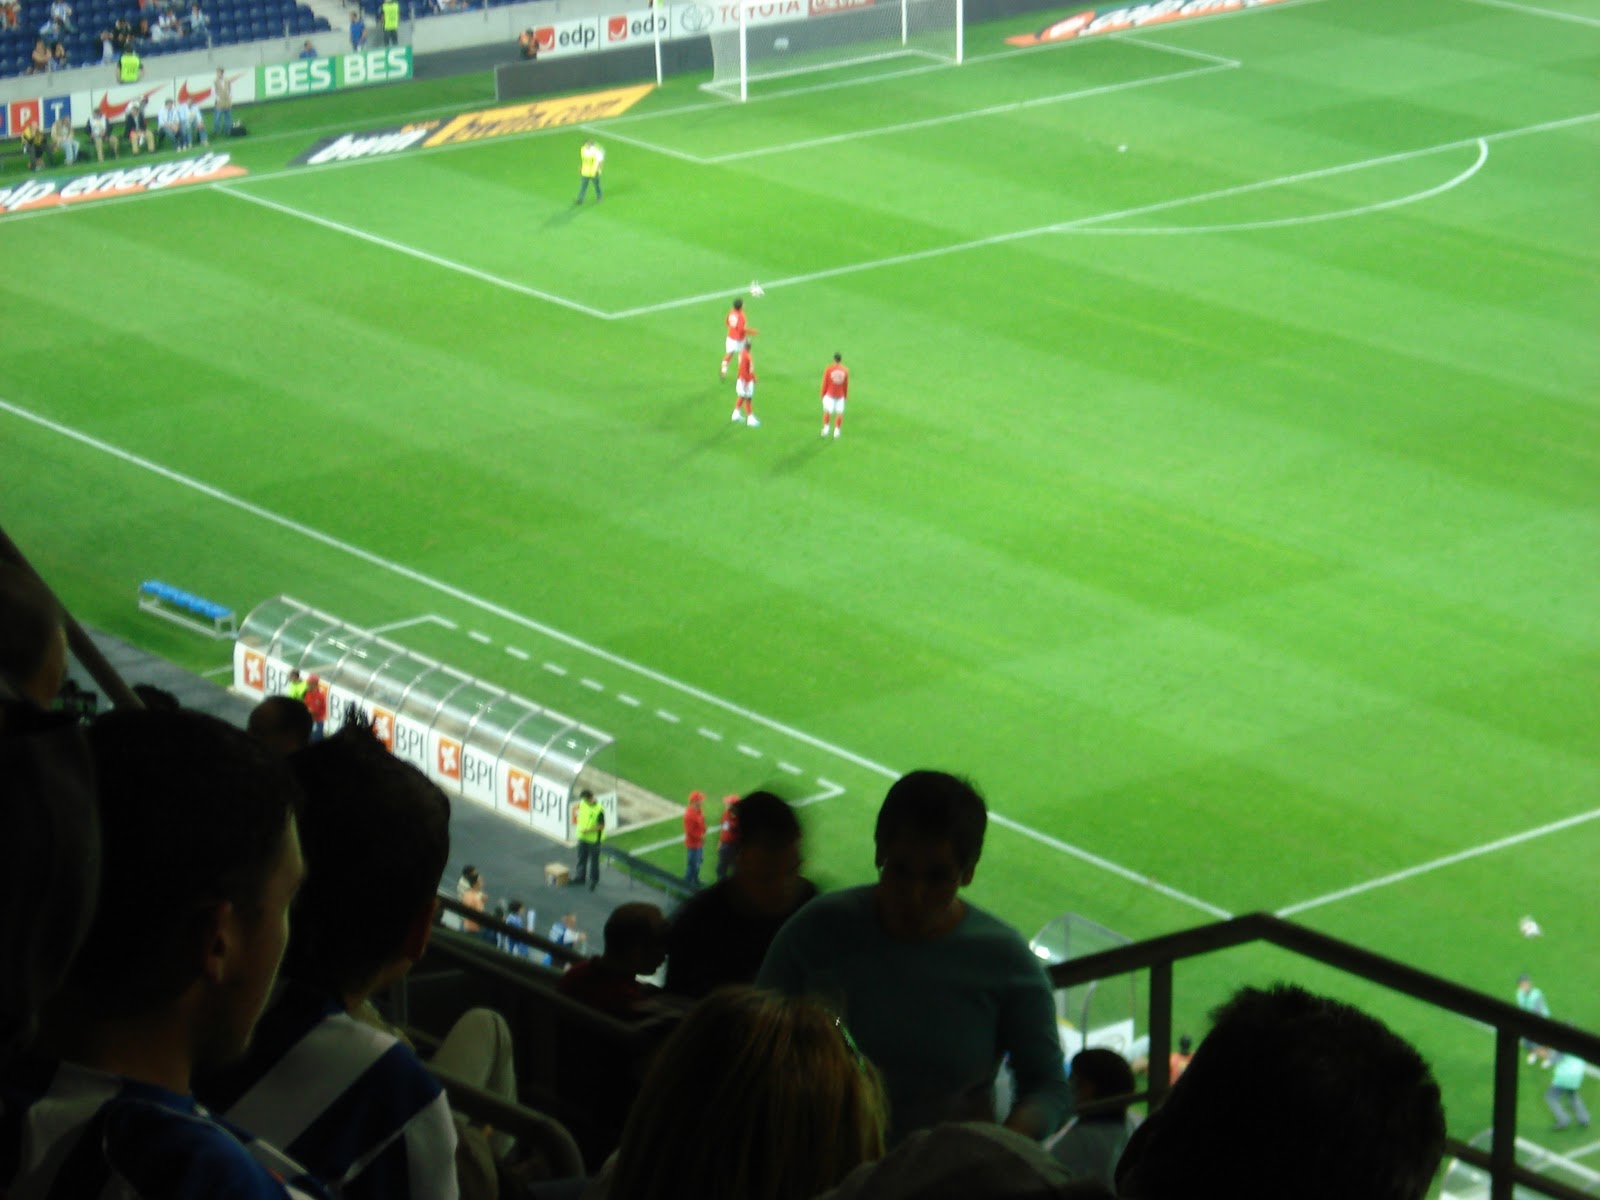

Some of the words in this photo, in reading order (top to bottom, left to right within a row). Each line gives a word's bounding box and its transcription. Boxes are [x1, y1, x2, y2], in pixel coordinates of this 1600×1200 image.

[558, 22, 596, 49] edp
[264, 58, 332, 96] BES
[343, 47, 408, 86] BES
[395, 723, 425, 759] BPI
[463, 753, 493, 791] BPI
[532, 781, 563, 822] BPI
